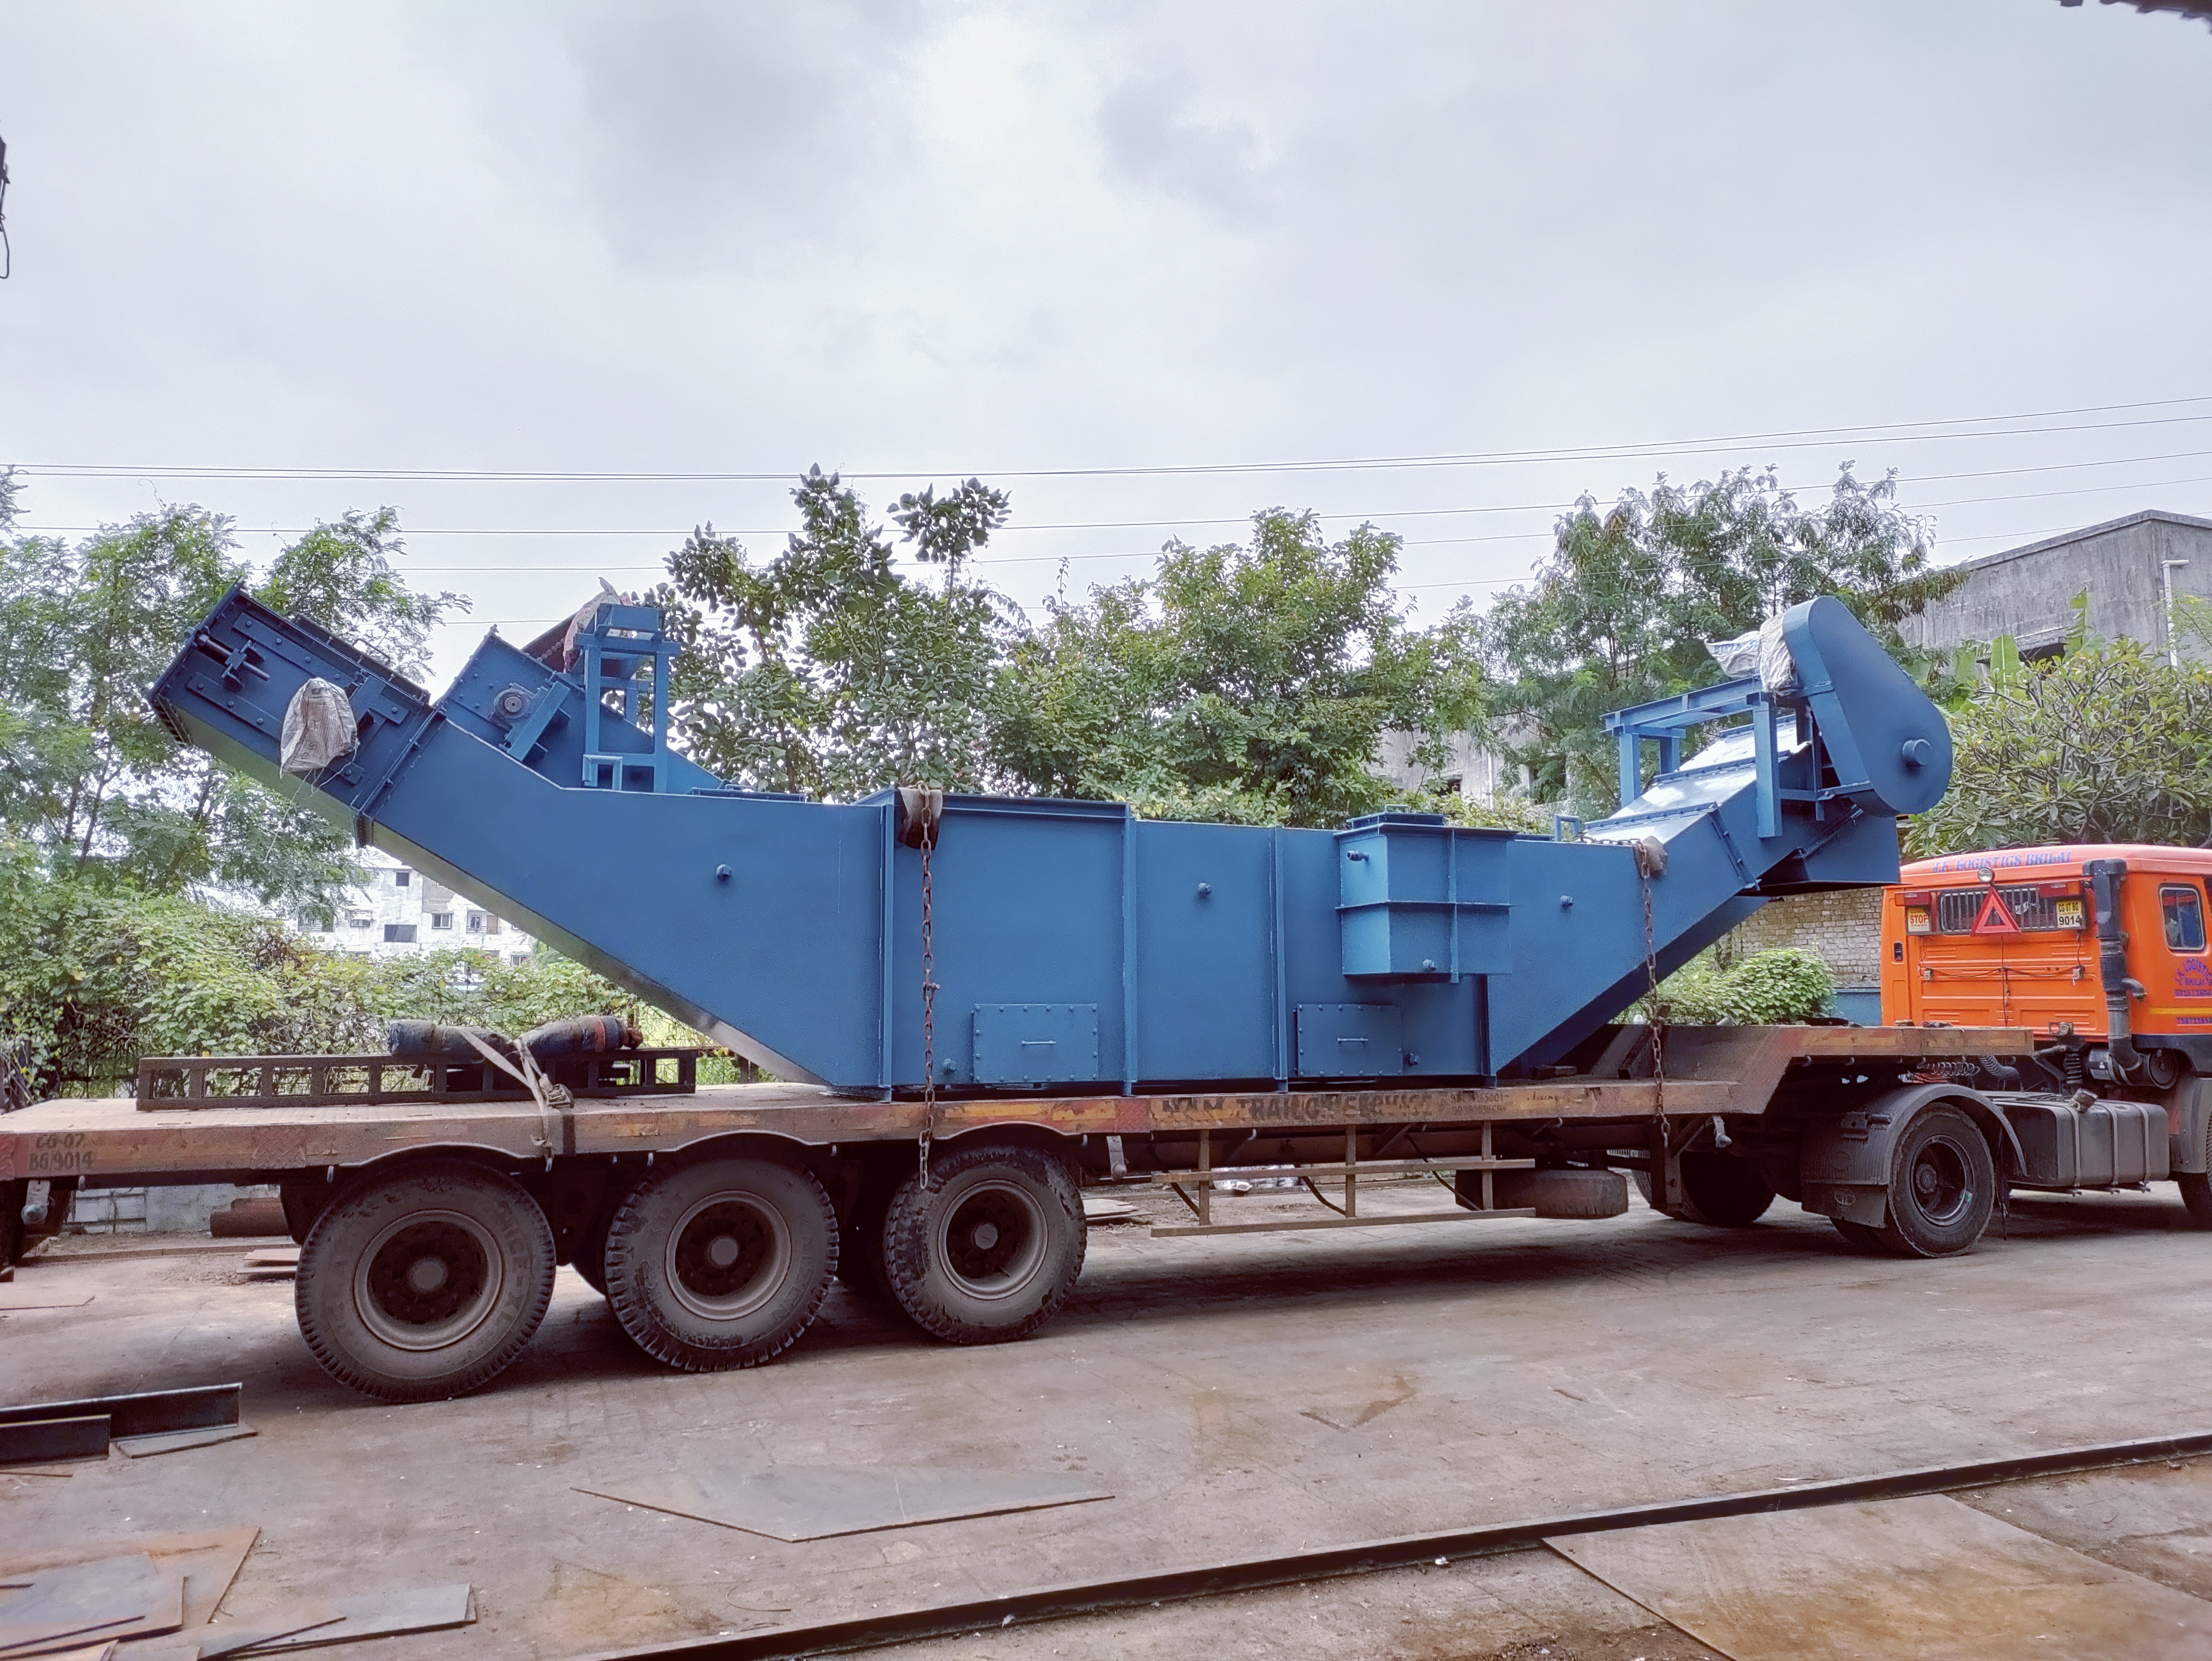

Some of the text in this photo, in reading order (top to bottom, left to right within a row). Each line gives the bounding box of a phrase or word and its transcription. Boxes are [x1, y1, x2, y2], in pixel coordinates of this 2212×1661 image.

[2025, 851, 2071, 866] BHILAI
[2058, 902, 2079, 912] CG 07 BG
[1910, 914, 1927, 924] STOP
[2059, 915, 2082, 926] 9014
